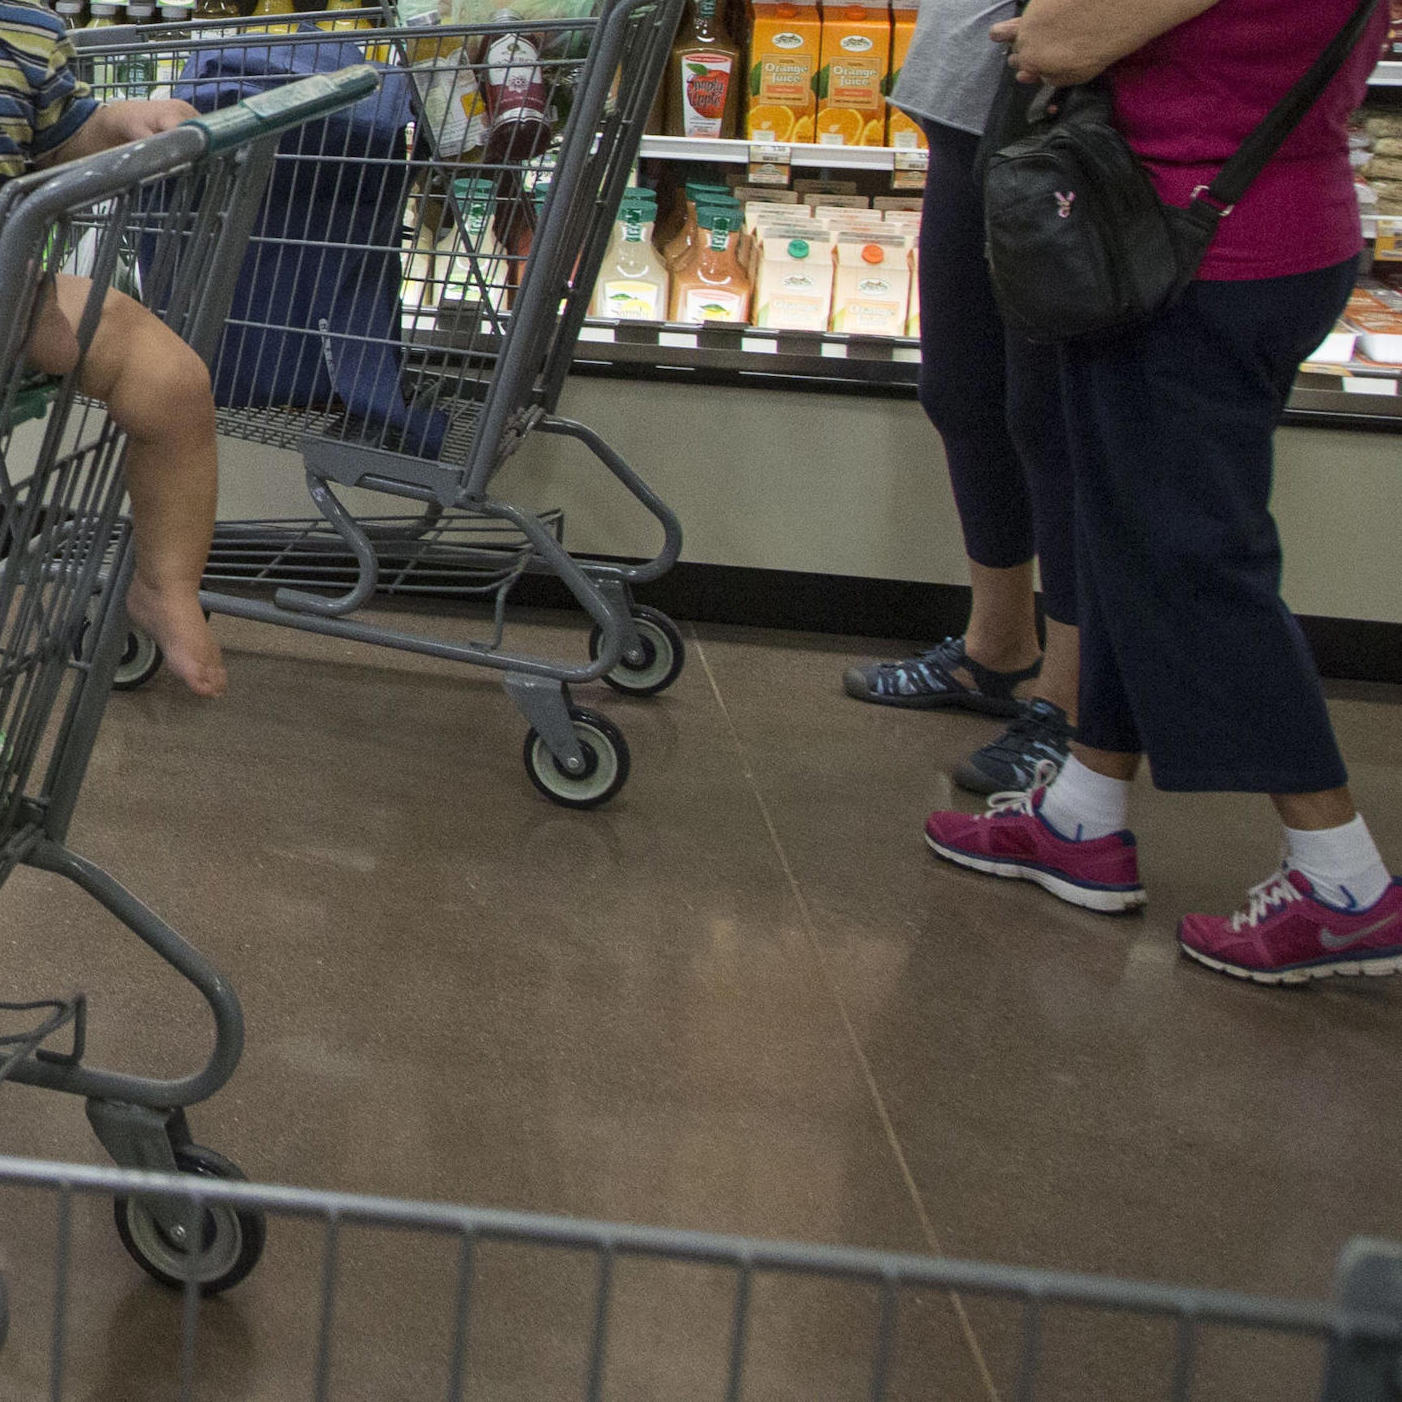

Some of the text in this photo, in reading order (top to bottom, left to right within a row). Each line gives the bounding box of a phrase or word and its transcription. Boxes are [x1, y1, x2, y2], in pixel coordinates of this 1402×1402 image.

[764, 61, 809, 79] Orange
[833, 64, 877, 81] Orange
[772, 299, 819, 315] Orange
